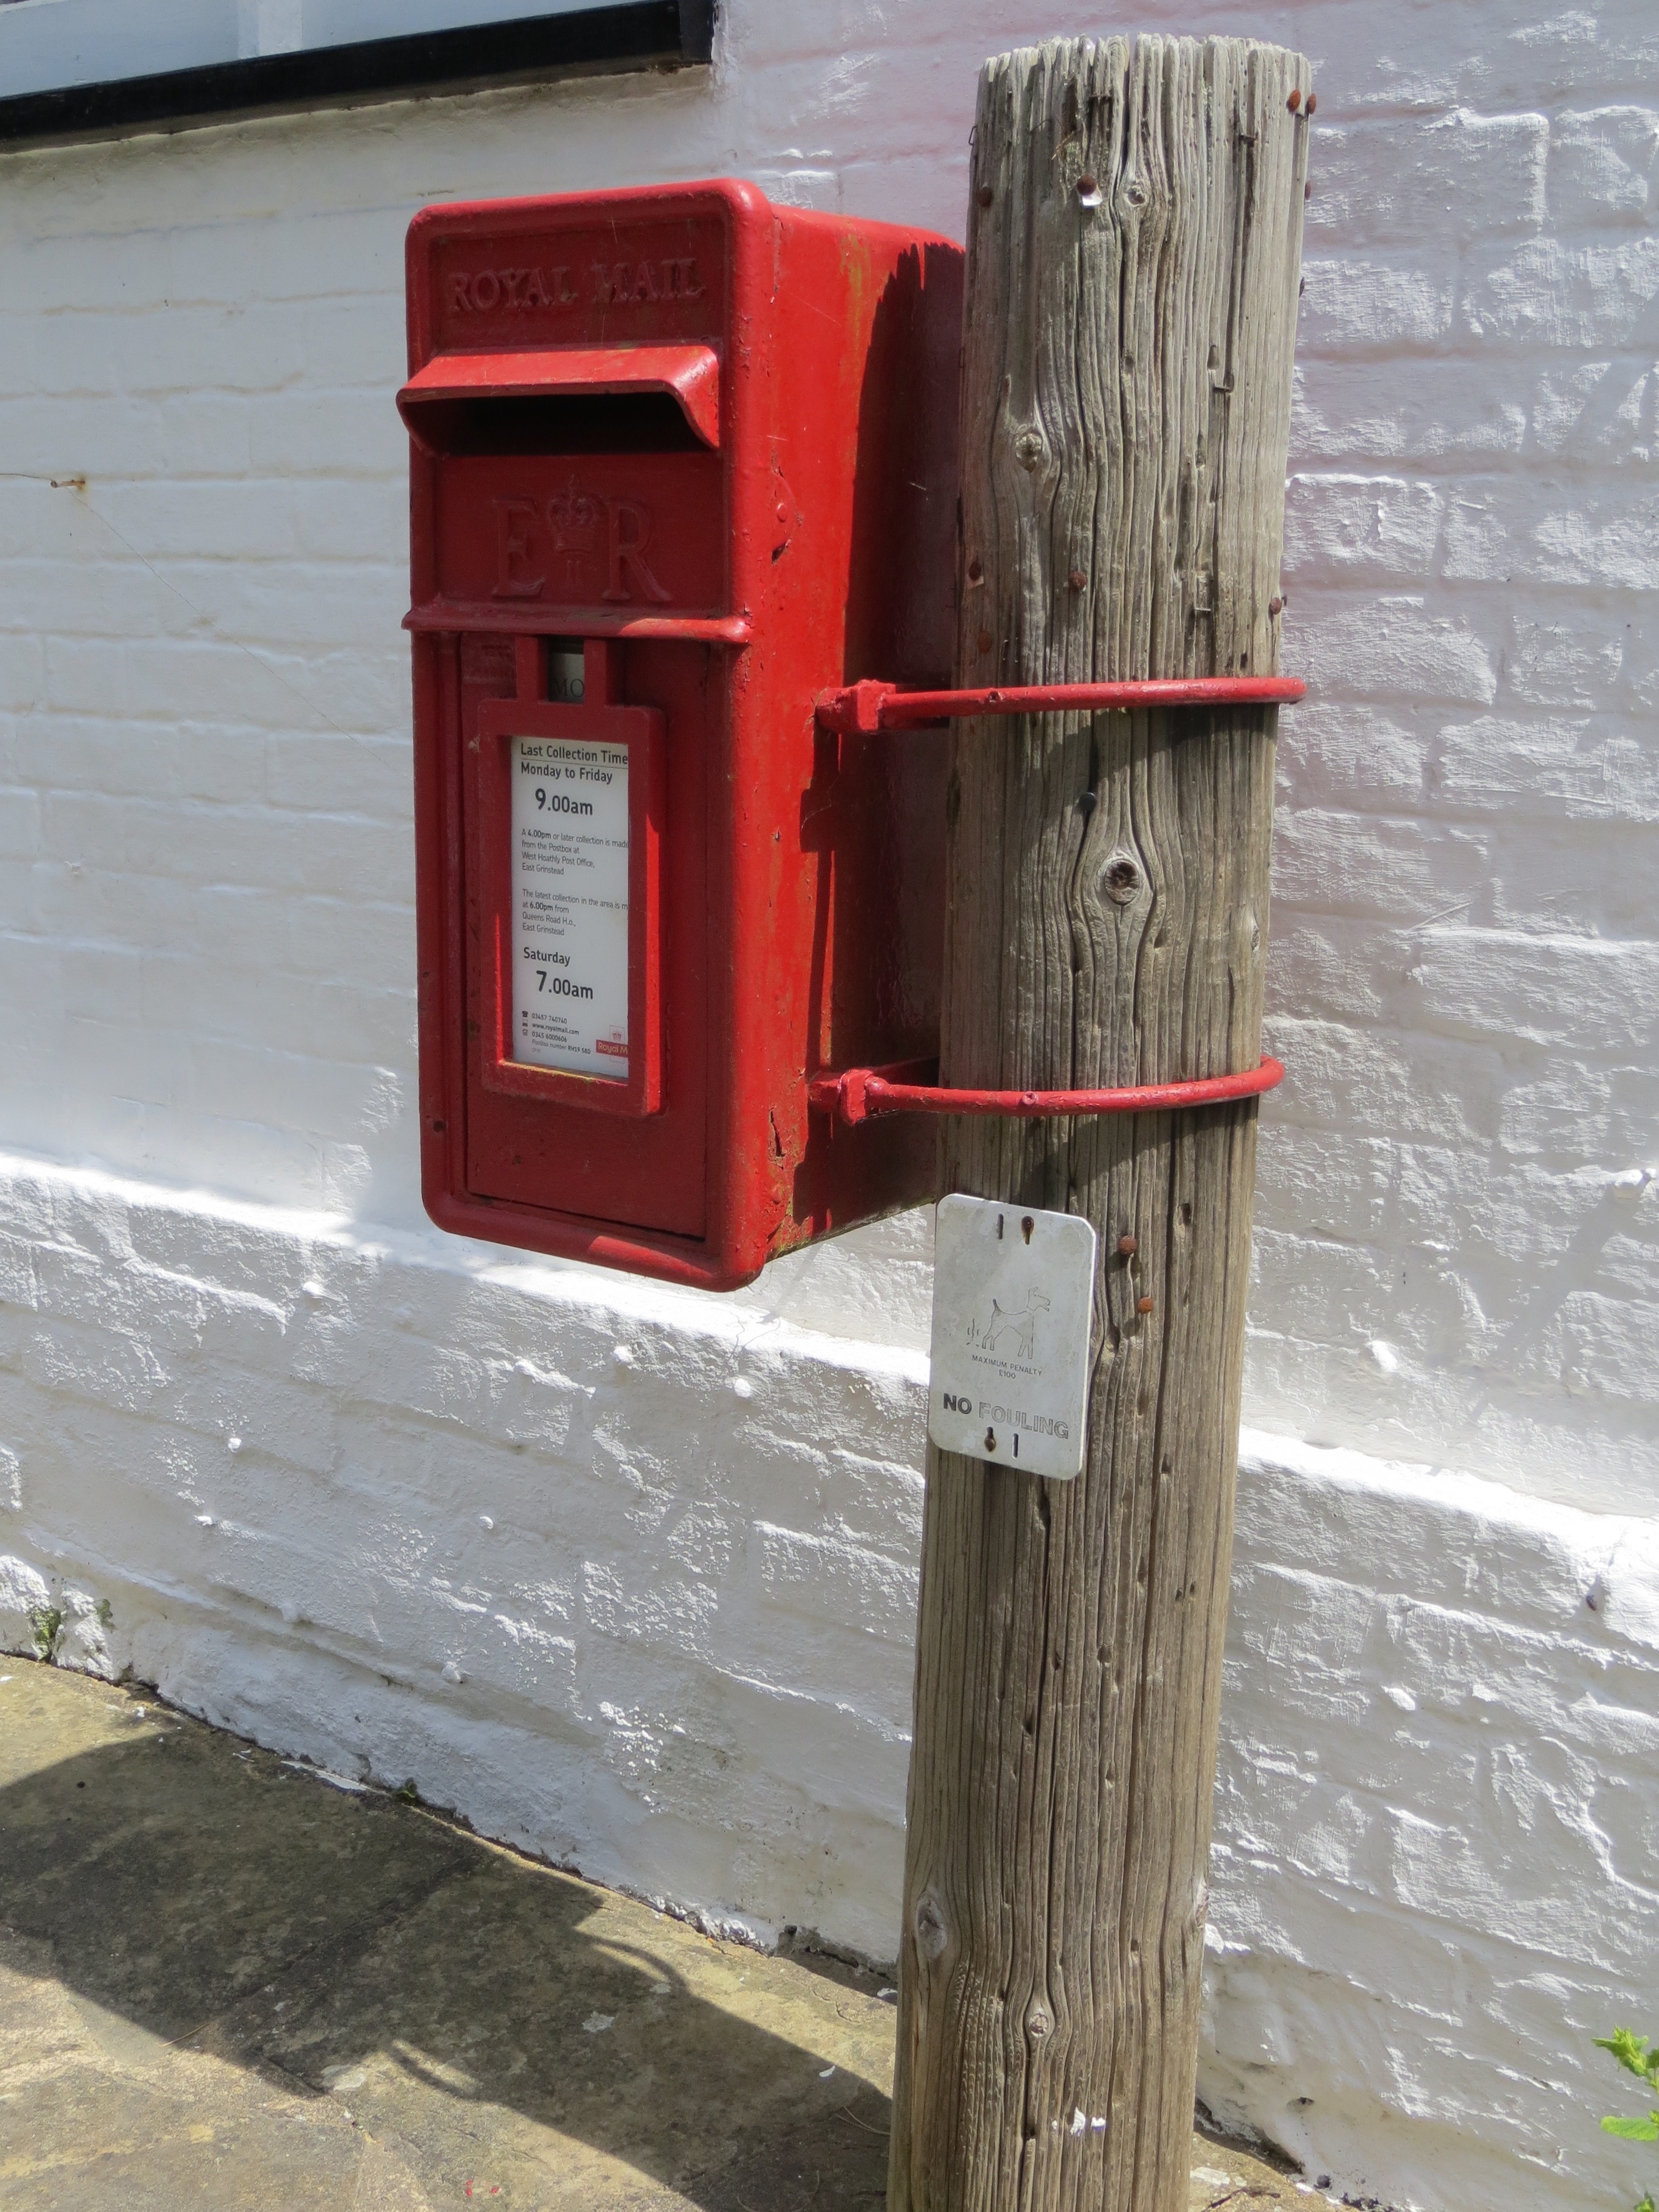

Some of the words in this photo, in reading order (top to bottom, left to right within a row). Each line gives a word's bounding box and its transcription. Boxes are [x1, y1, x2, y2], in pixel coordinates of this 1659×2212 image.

[447, 266, 578, 312] ROYAL
[591, 257, 707, 304] MAIL
[521, 743, 542, 757] Last
[546, 745, 597, 761] Collection
[601, 750, 628, 764] Time
[521, 762, 561, 779] Monday
[565, 767, 575, 779] to
[580, 768, 612, 784] Friday
[535, 788, 593, 815] 9.00am
[521, 839, 536, 848] from
[538, 841, 547, 850] the
[549, 843, 572, 853] Postbox
[528, 830, 551, 839] 4.00pm
[561, 833, 574, 842] later
[576, 836, 603, 845] collection
[612, 840, 628, 848] made
[521, 851, 536, 860] West
[538, 853, 560, 864] Hoathly
[562, 856, 575, 865] Post
[577, 858, 594, 868] Office,
[522, 863, 534, 872] East
[536, 864, 564, 875] Grinstead
[523, 888, 534, 898] The
[535, 890, 551, 900] latest
[552, 894, 579, 904] collection
[589, 898, 598, 906] the
[615, 901, 620, 909] is
[530, 901, 553, 912] 6.00pm
[555, 905, 569, 913] from
[523, 911, 544, 921] Queens
[546, 914, 560, 924] Road
[523, 922, 534, 931] East
[536, 925, 564, 936] Grinstead
[524, 947, 570, 967] Saturday
[536, 971, 593, 999] 7.00am
[549, 1015, 567, 1024] 740740
[531, 1023, 580, 1035] www.royalmail.com
[598, 1042, 618, 1053] Royal
[972, 1355, 1007, 1368] MAXIMUM
[1010, 1364, 1042, 1376] PENALTY
[999, 1369, 1016, 1379] £100
[943, 1393, 972, 1414] NO
[979, 1401, 1068, 1439] FOULING
